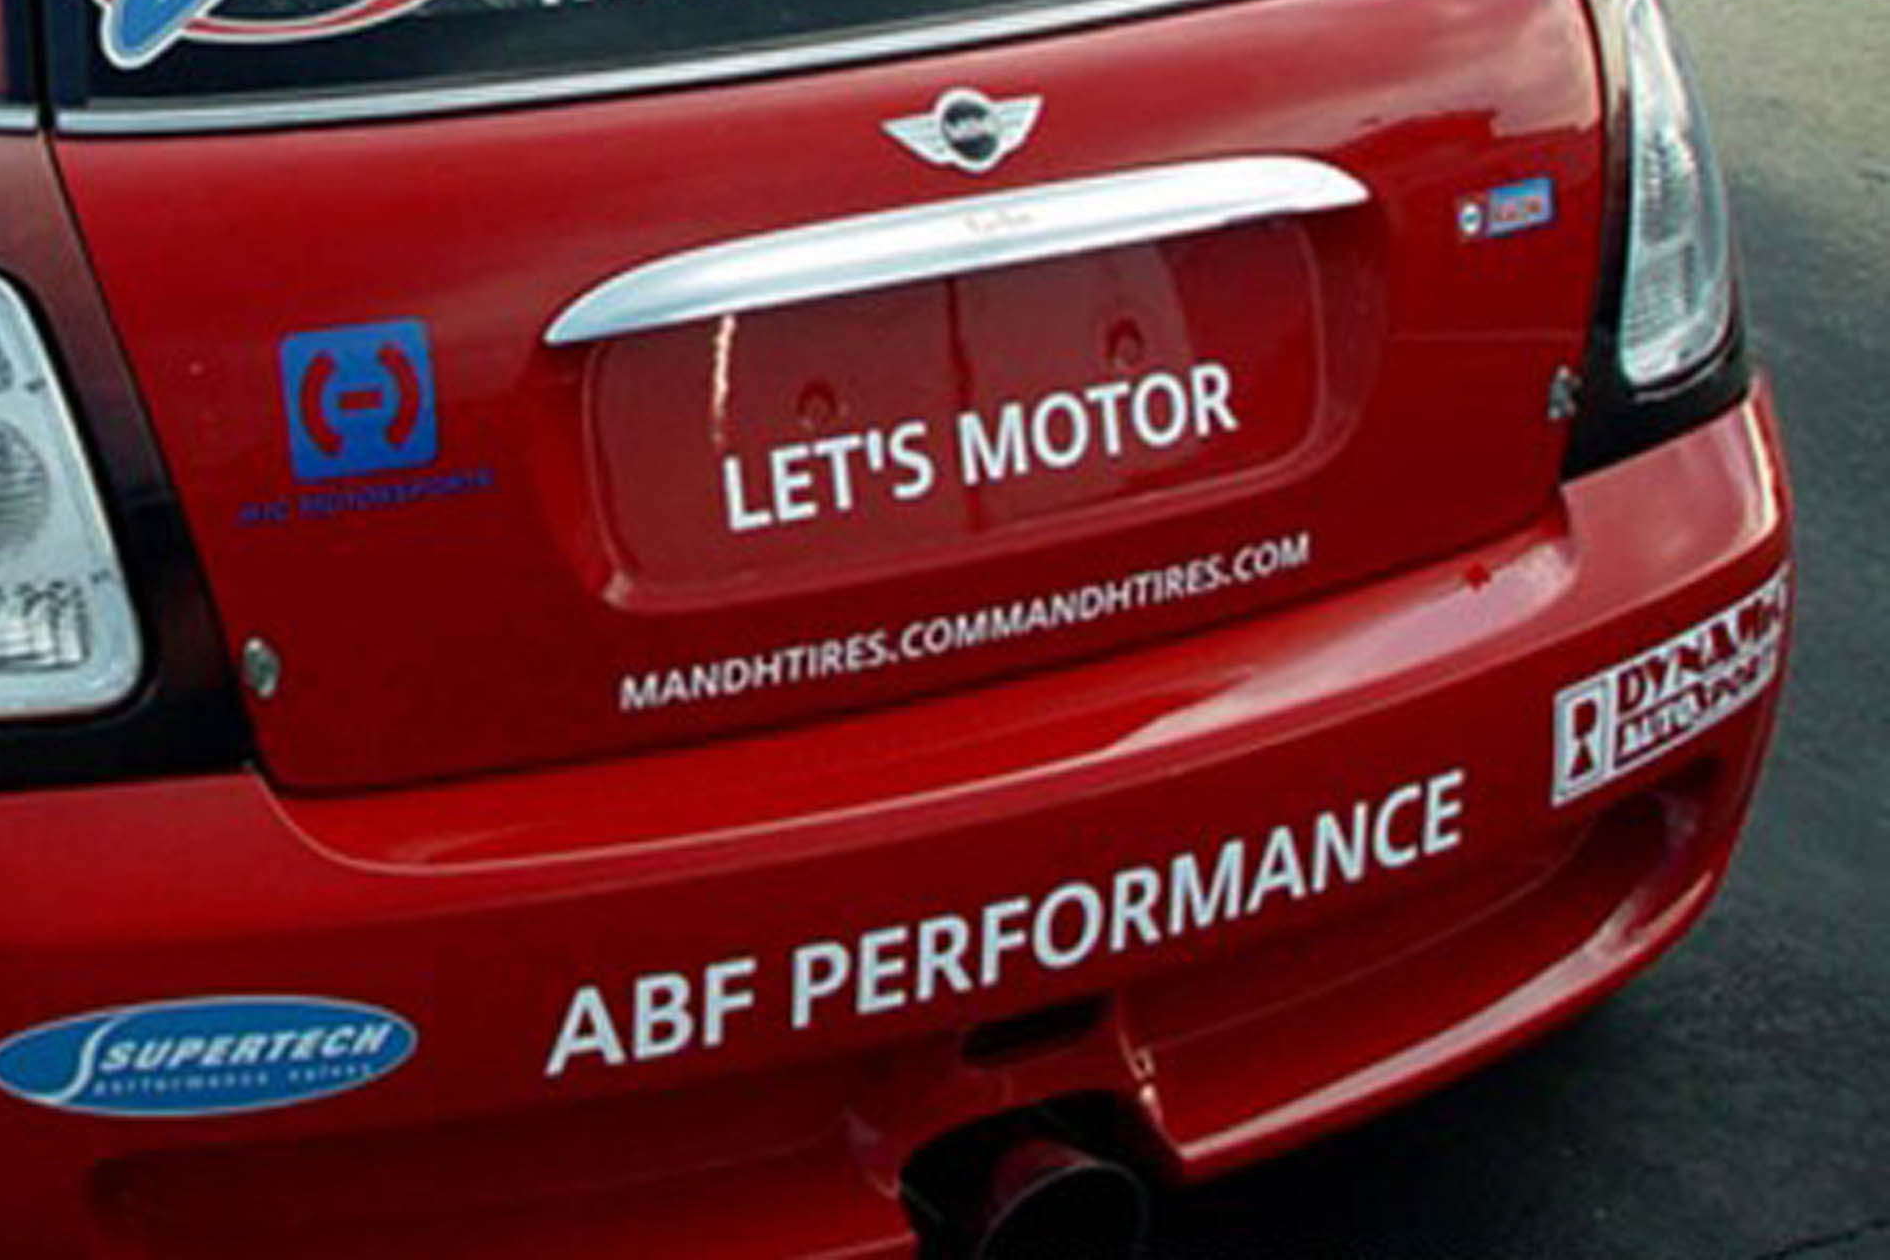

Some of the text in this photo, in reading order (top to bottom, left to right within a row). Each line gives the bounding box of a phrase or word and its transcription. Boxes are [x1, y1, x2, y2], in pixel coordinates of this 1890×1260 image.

[723, 362, 1240, 532] LET'S MOTOR
[619, 533, 1310, 712] MANDHTIRES.COMMANDHTIRES.COM
[543, 769, 1466, 1078] ABF PERFORMANCE
[99, 1022, 394, 1073] SUPERTECH
